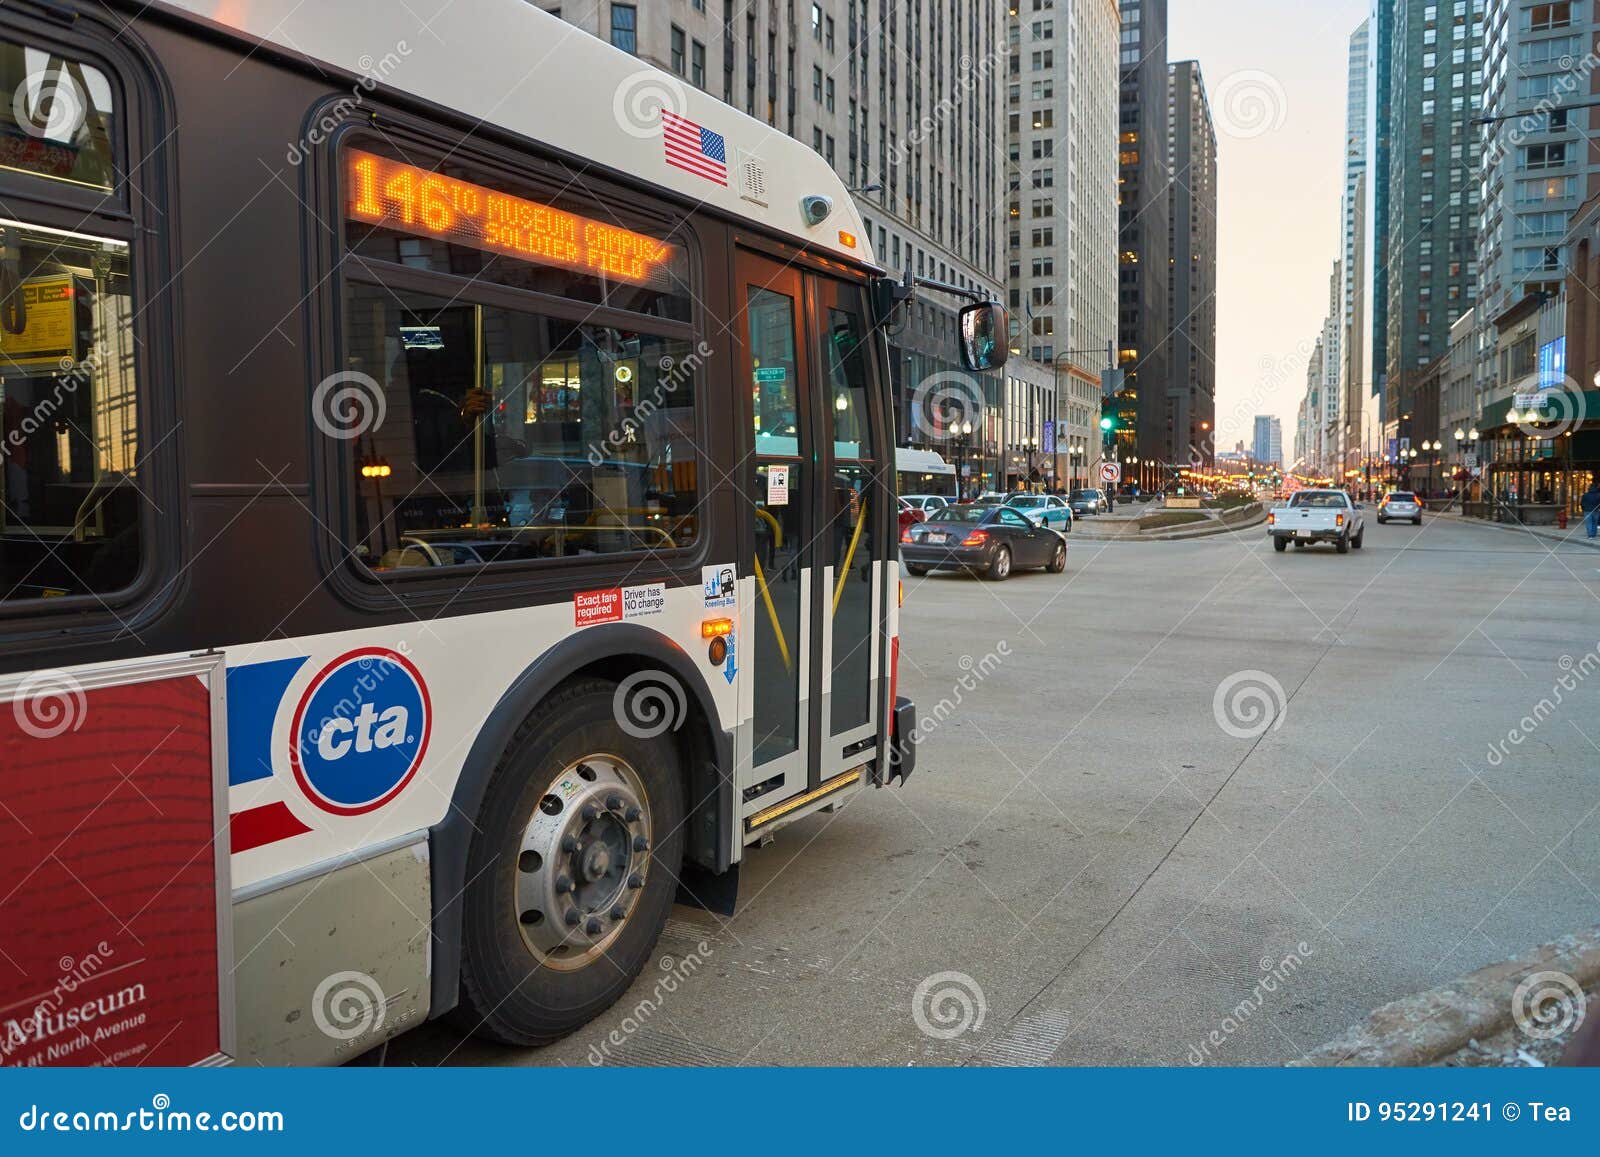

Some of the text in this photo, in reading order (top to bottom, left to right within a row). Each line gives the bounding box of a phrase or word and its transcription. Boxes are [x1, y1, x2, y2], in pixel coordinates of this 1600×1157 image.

[355, 160, 450, 231] 146
[450, 184, 478, 215] TO
[487, 194, 577, 242] MUSEUM
[485, 221, 643, 279] SOLDIER FIELD
[577, 592, 618, 607] Exact fare
[577, 603, 612, 618] required
[624, 586, 661, 600] Driver has
[624, 597, 664, 610] NO change
[318, 702, 409, 761] cta
[3, 983, 147, 1050] Museum
[47, 1033, 91, 1061] North
[93, 1012, 147, 1042] Avenue
